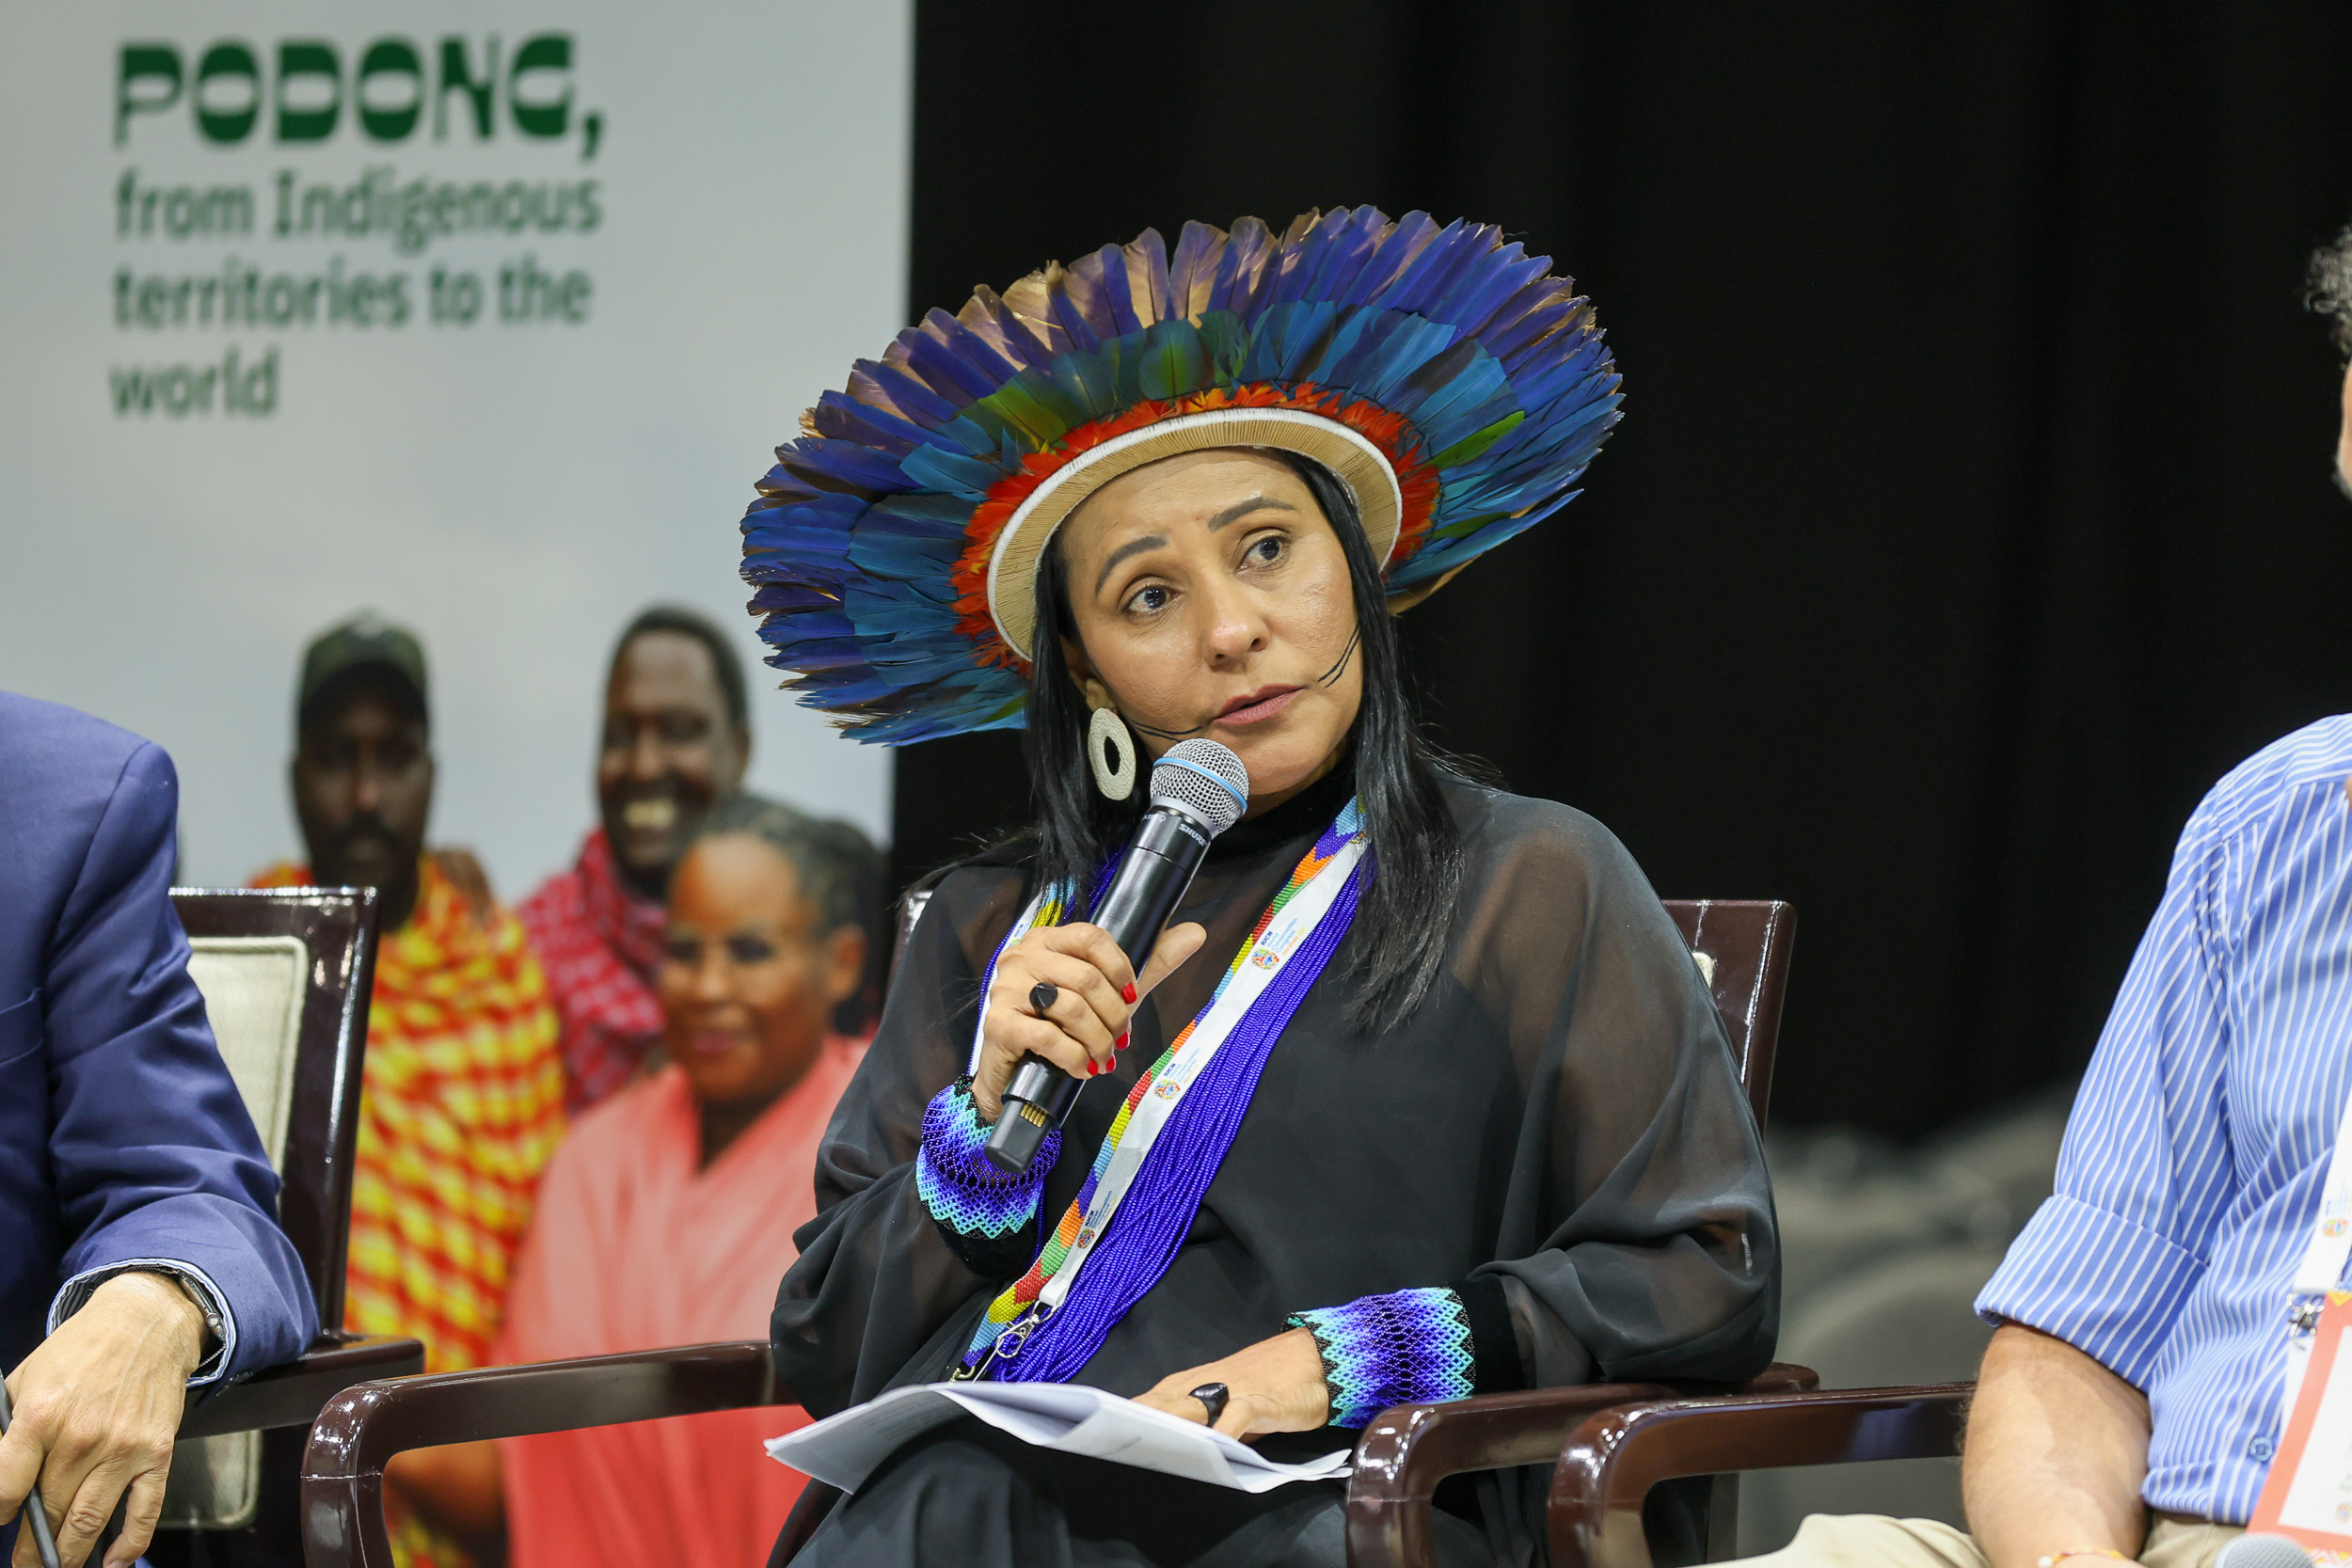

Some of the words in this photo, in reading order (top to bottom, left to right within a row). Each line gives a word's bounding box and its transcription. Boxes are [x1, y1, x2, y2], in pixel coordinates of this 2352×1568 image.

[114, 32, 605, 164] PODONG,
[116, 166, 254, 235] from
[275, 164, 603, 255] Indigenous
[114, 255, 412, 327] territories
[430, 262, 484, 327] to
[499, 251, 594, 325] the
[110, 344, 280, 418] world
[1178, 823, 1207, 847] SHURE
[1261, 931, 1273, 945] IUCN
[1164, 1063, 1176, 1076] IUCN
[1085, 1211, 1094, 1227] IUCN
